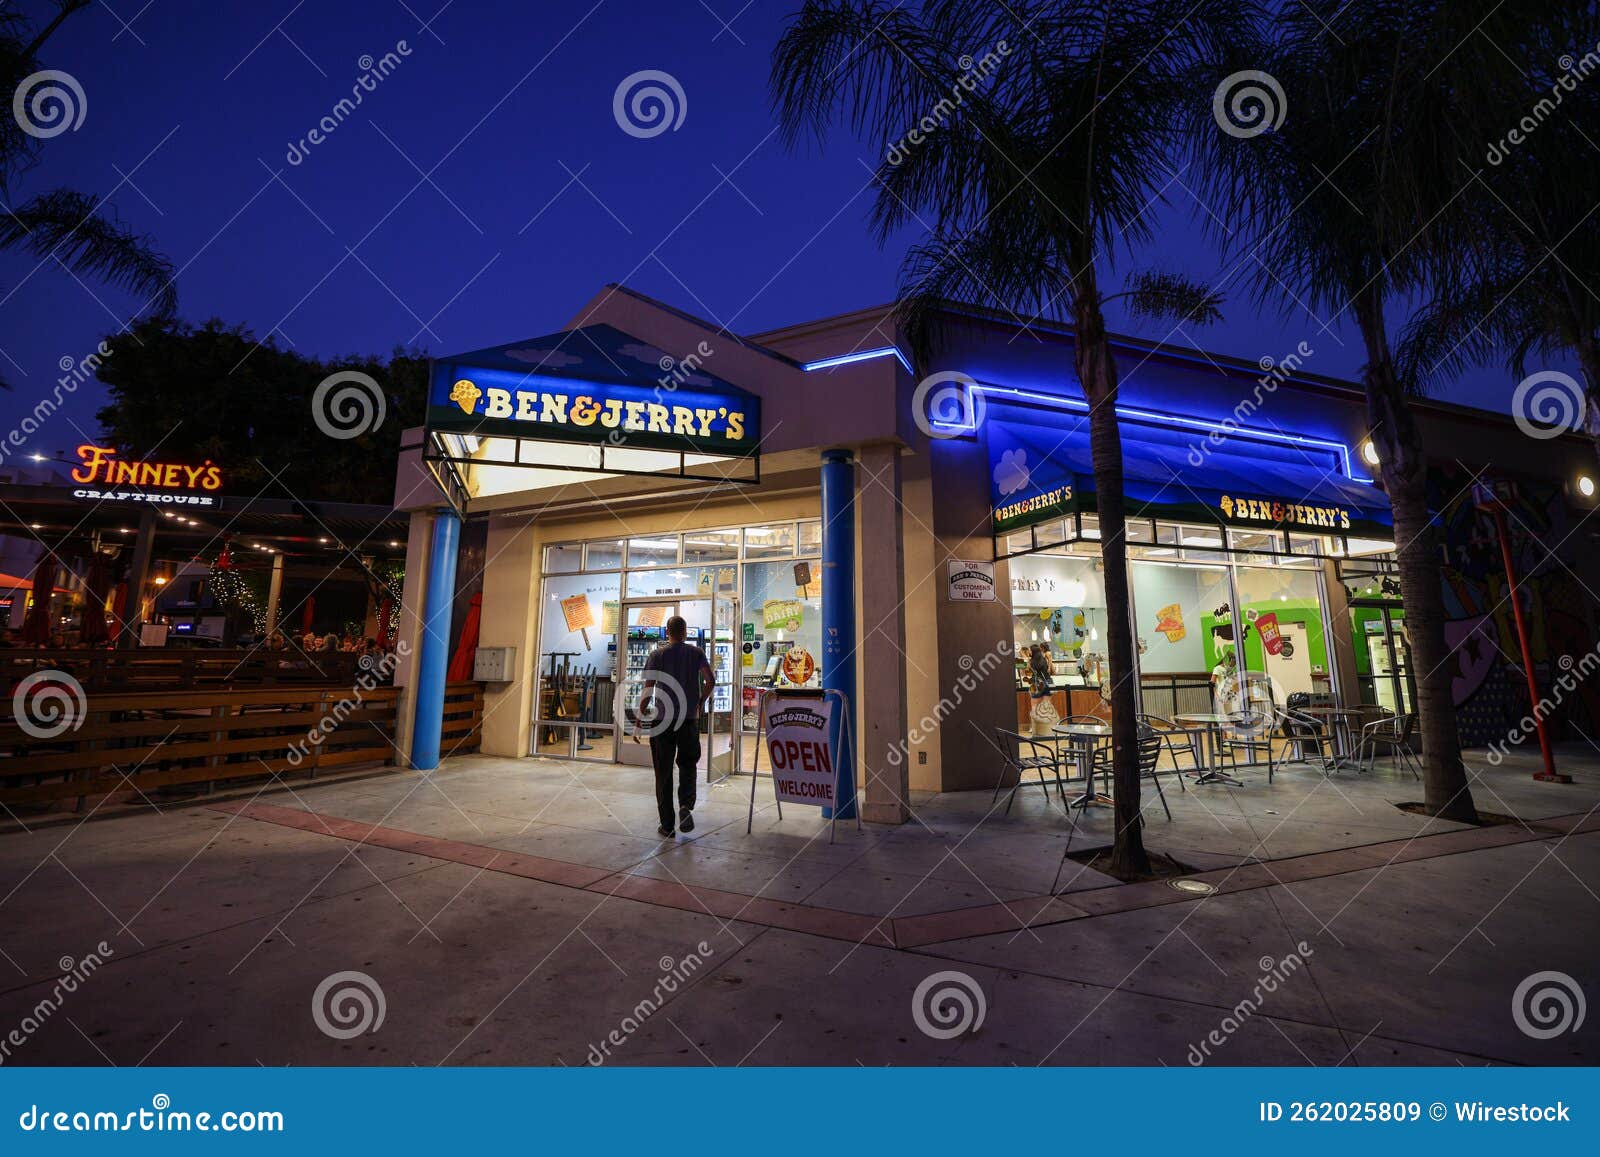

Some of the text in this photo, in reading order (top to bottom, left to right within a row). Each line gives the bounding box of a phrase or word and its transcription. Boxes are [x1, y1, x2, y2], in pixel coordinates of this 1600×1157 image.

[484, 387, 745, 441] BEN&JERRY'S
[70, 444, 223, 490] FINNEY'S
[73, 489, 213, 505] CRAFTHOUSE
[1001, 485, 1073, 521] BEN&JERRY'S
[1235, 498, 1350, 529] BEN&JERRY'S
[964, 562, 979, 570] FOR
[962, 591, 983, 599] ONLY
[770, 739, 832, 773] OPEN
[778, 780, 833, 800] WELCOME
